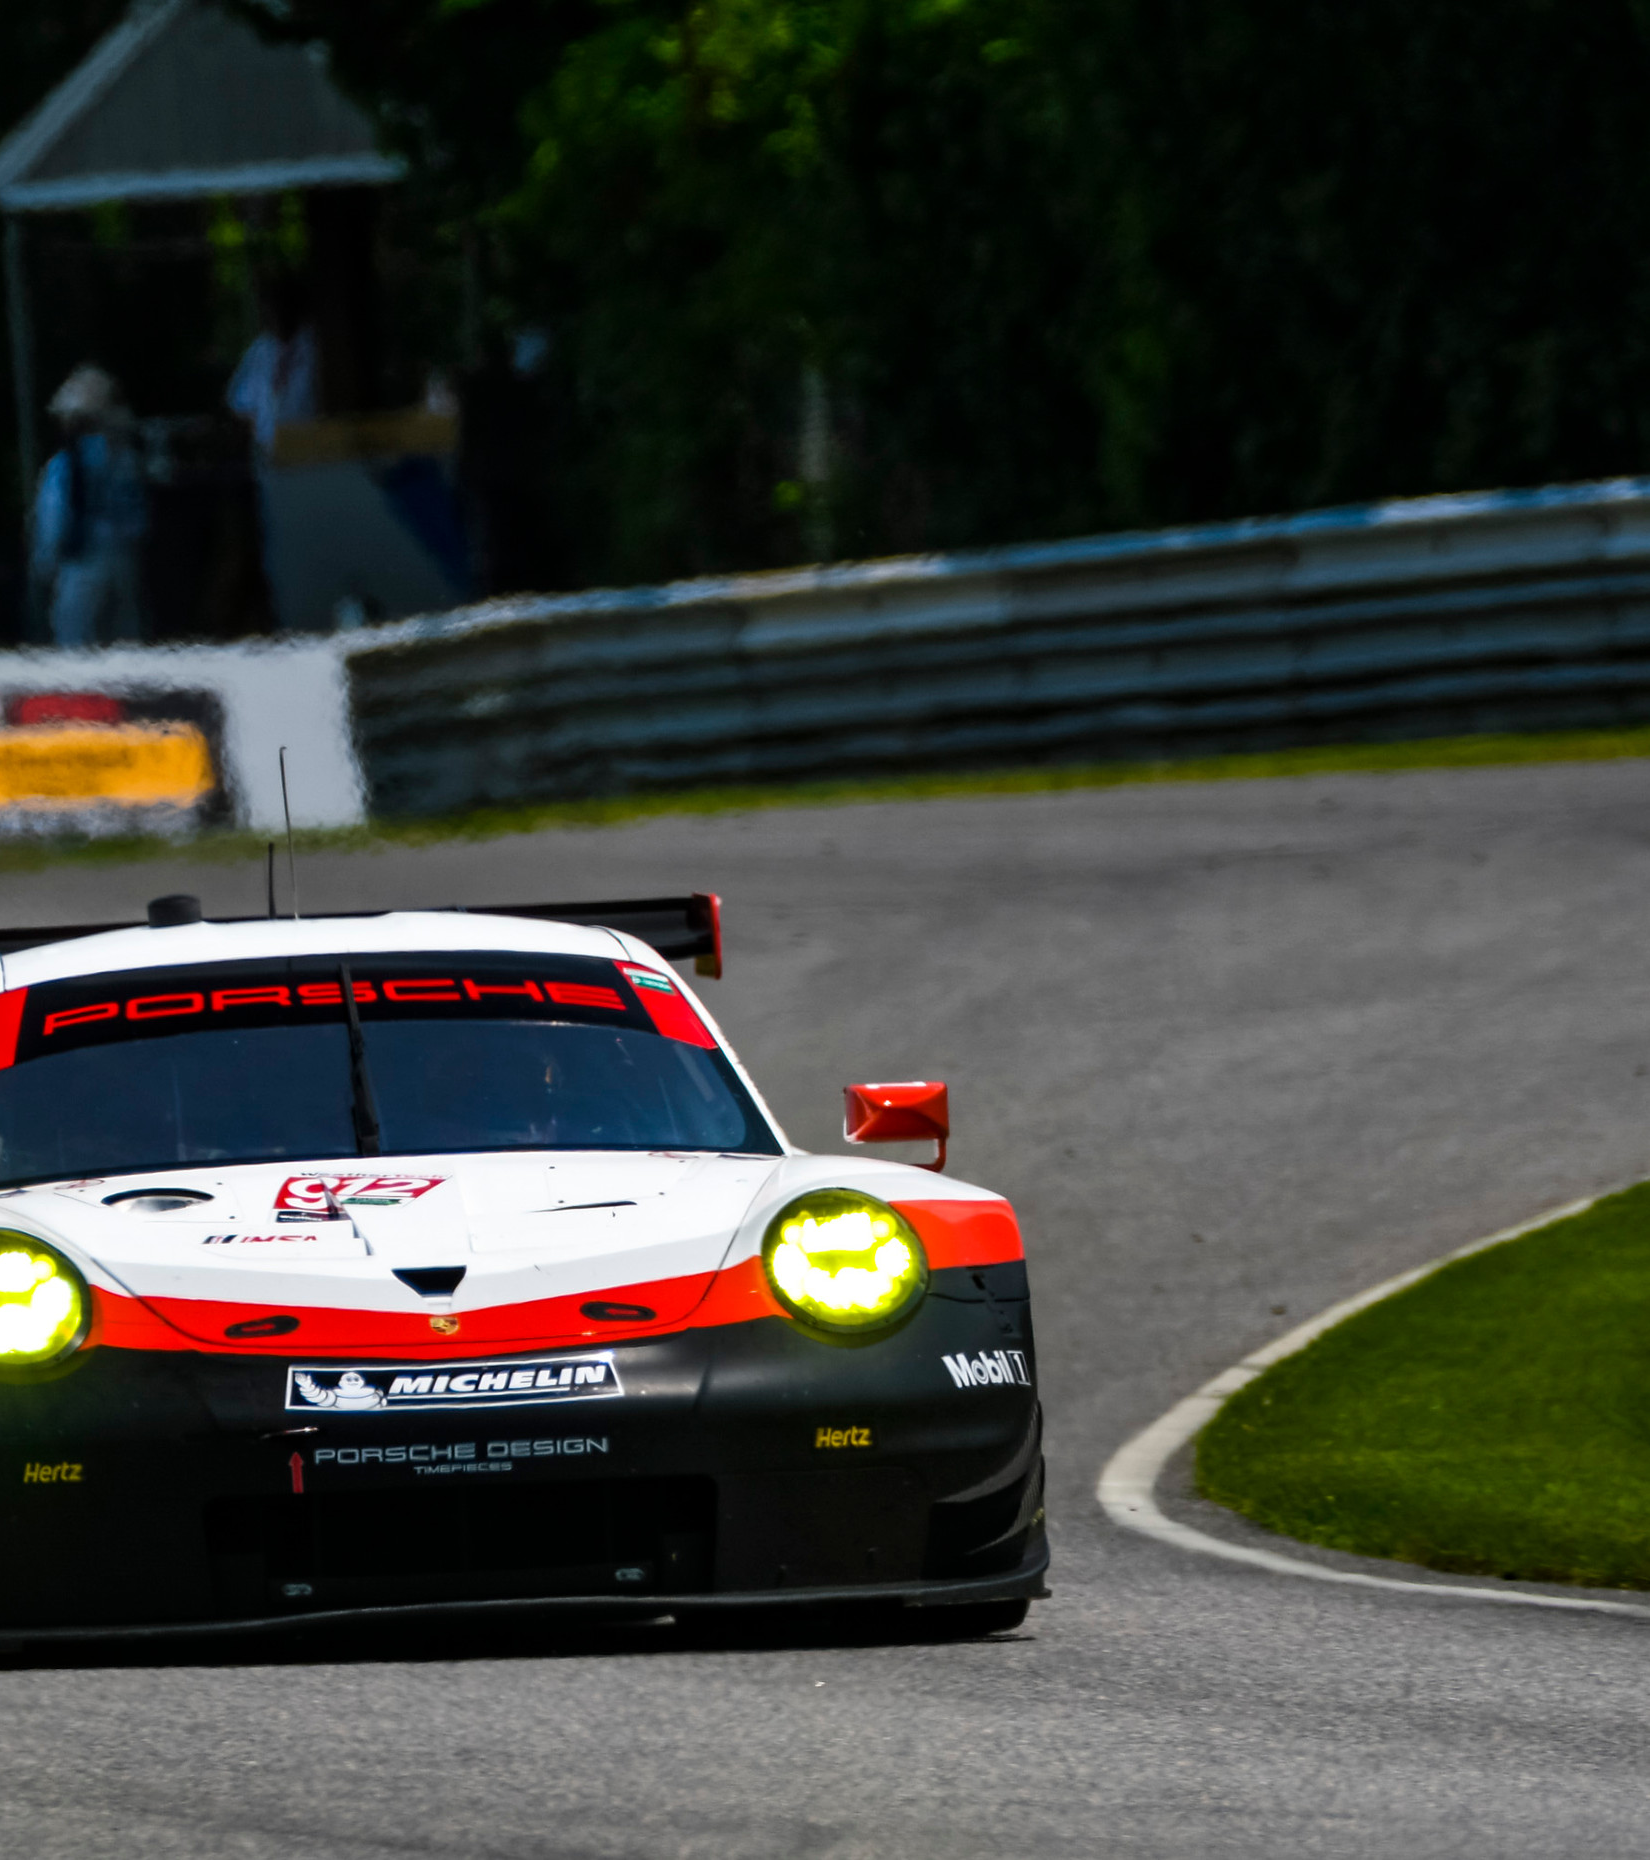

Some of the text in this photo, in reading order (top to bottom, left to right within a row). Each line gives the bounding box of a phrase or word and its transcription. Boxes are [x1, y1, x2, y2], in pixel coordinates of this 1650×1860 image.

[43, 979, 627, 1035] PORSCHE
[388, 1365, 607, 1395] MICHELIN
[941, 1350, 1015, 1389] Mobil
[814, 1425, 873, 1448] Hertz
[314, 1437, 609, 1465] PORSCHE DESIGN
[23, 1461, 83, 1483] Hertz
[413, 1461, 513, 1475] TIMEPIECES
